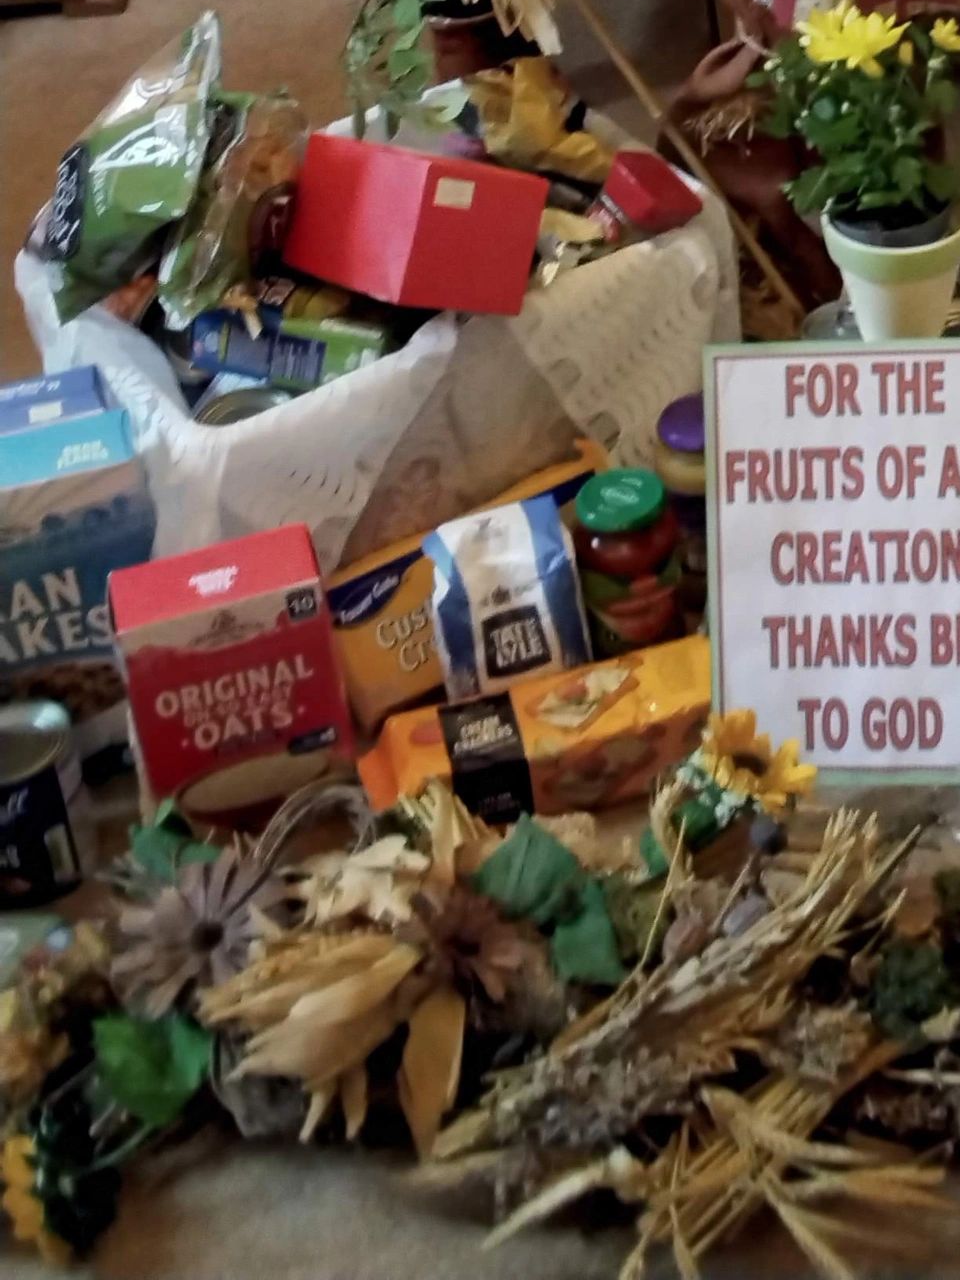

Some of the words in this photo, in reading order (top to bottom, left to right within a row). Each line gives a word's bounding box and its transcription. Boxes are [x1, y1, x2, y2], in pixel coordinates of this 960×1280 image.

[785, 363, 861, 417] FOR
[872, 360, 946, 415] THE
[725, 447, 865, 503] FRUITS
[876, 446, 926, 500] OF
[0, 567, 82, 625] AN
[0, 604, 115, 664] AKES
[762, 615, 918, 669] THANKS
[155, 654, 314, 718] ORIGINAL
[193, 702, 294, 751] OATS
[798, 697, 849, 752] TO
[862, 696, 944, 752] GOD
